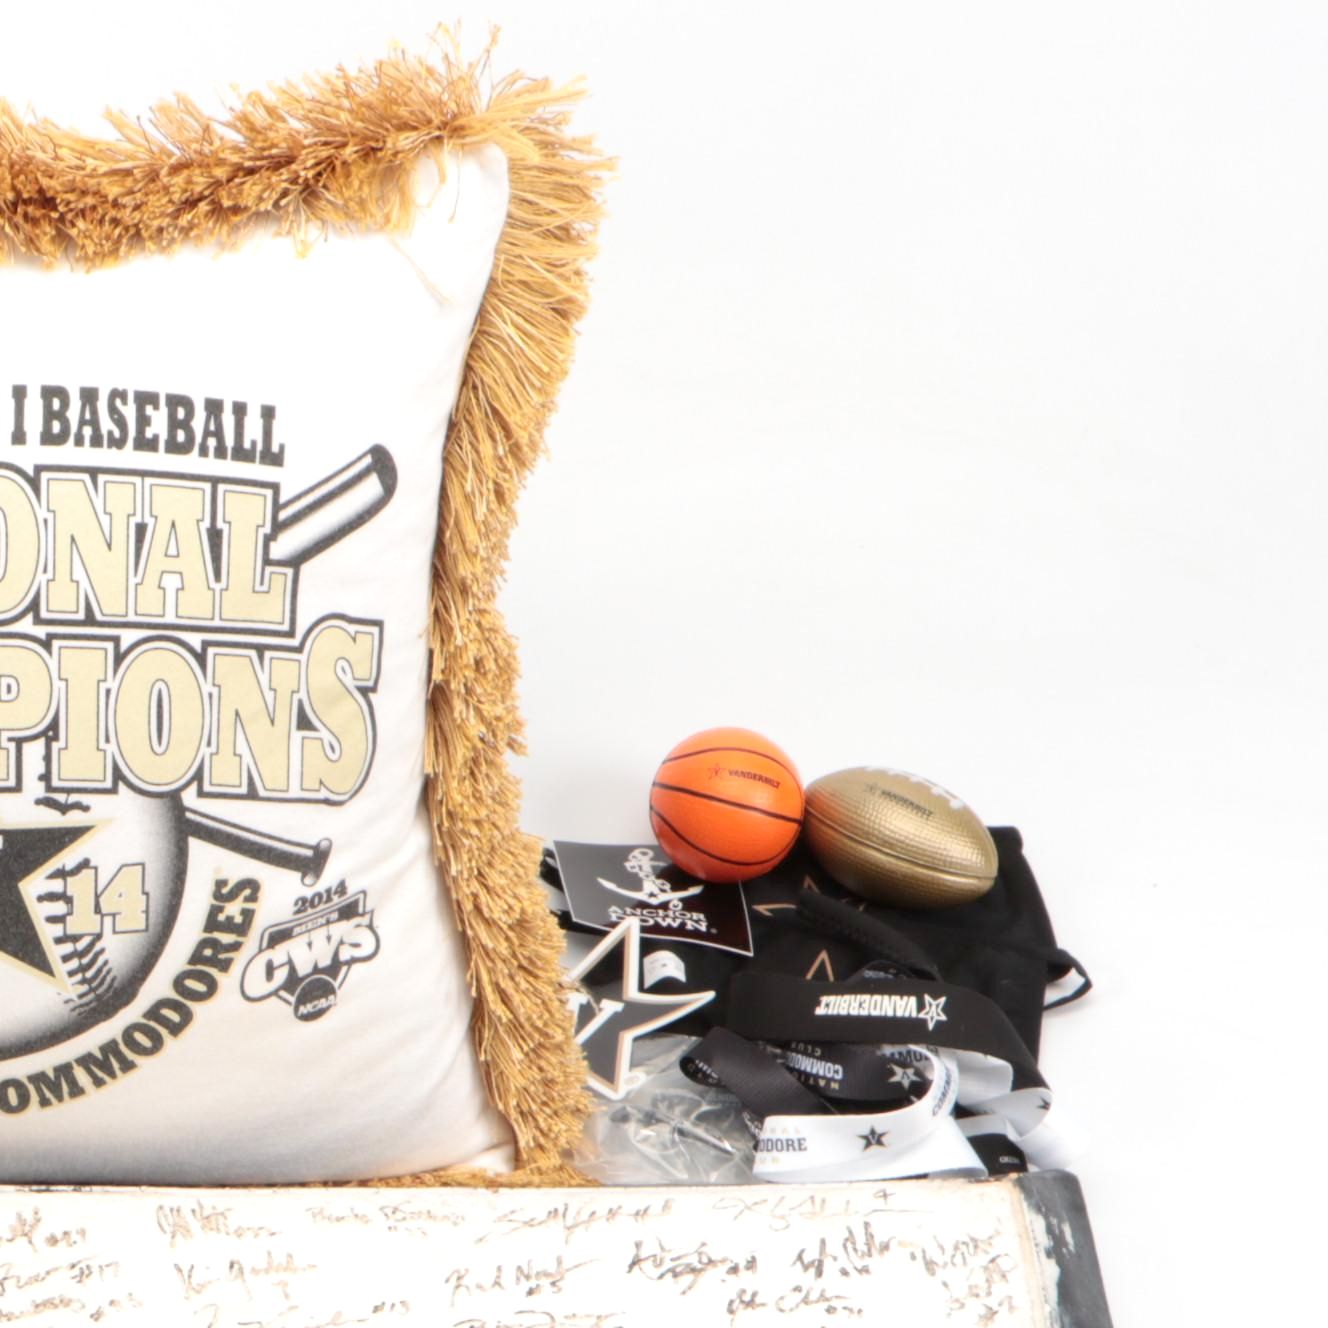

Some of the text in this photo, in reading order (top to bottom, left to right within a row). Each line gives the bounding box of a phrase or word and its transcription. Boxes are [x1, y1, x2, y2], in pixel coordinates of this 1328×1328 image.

[12, 384, 29, 445] I
[40, 387, 285, 466] BASEBALL
[728, 769, 780, 789] VANDERBILT
[292, 878, 348, 915] 2014
[608, 905, 706, 921] ANCHOR
[240, 908, 381, 1002] CWS
[297, 994, 337, 1016] NCAA
[815, 995, 917, 1018] VANDERBILT
[758, 1137, 807, 1152] ODORE
